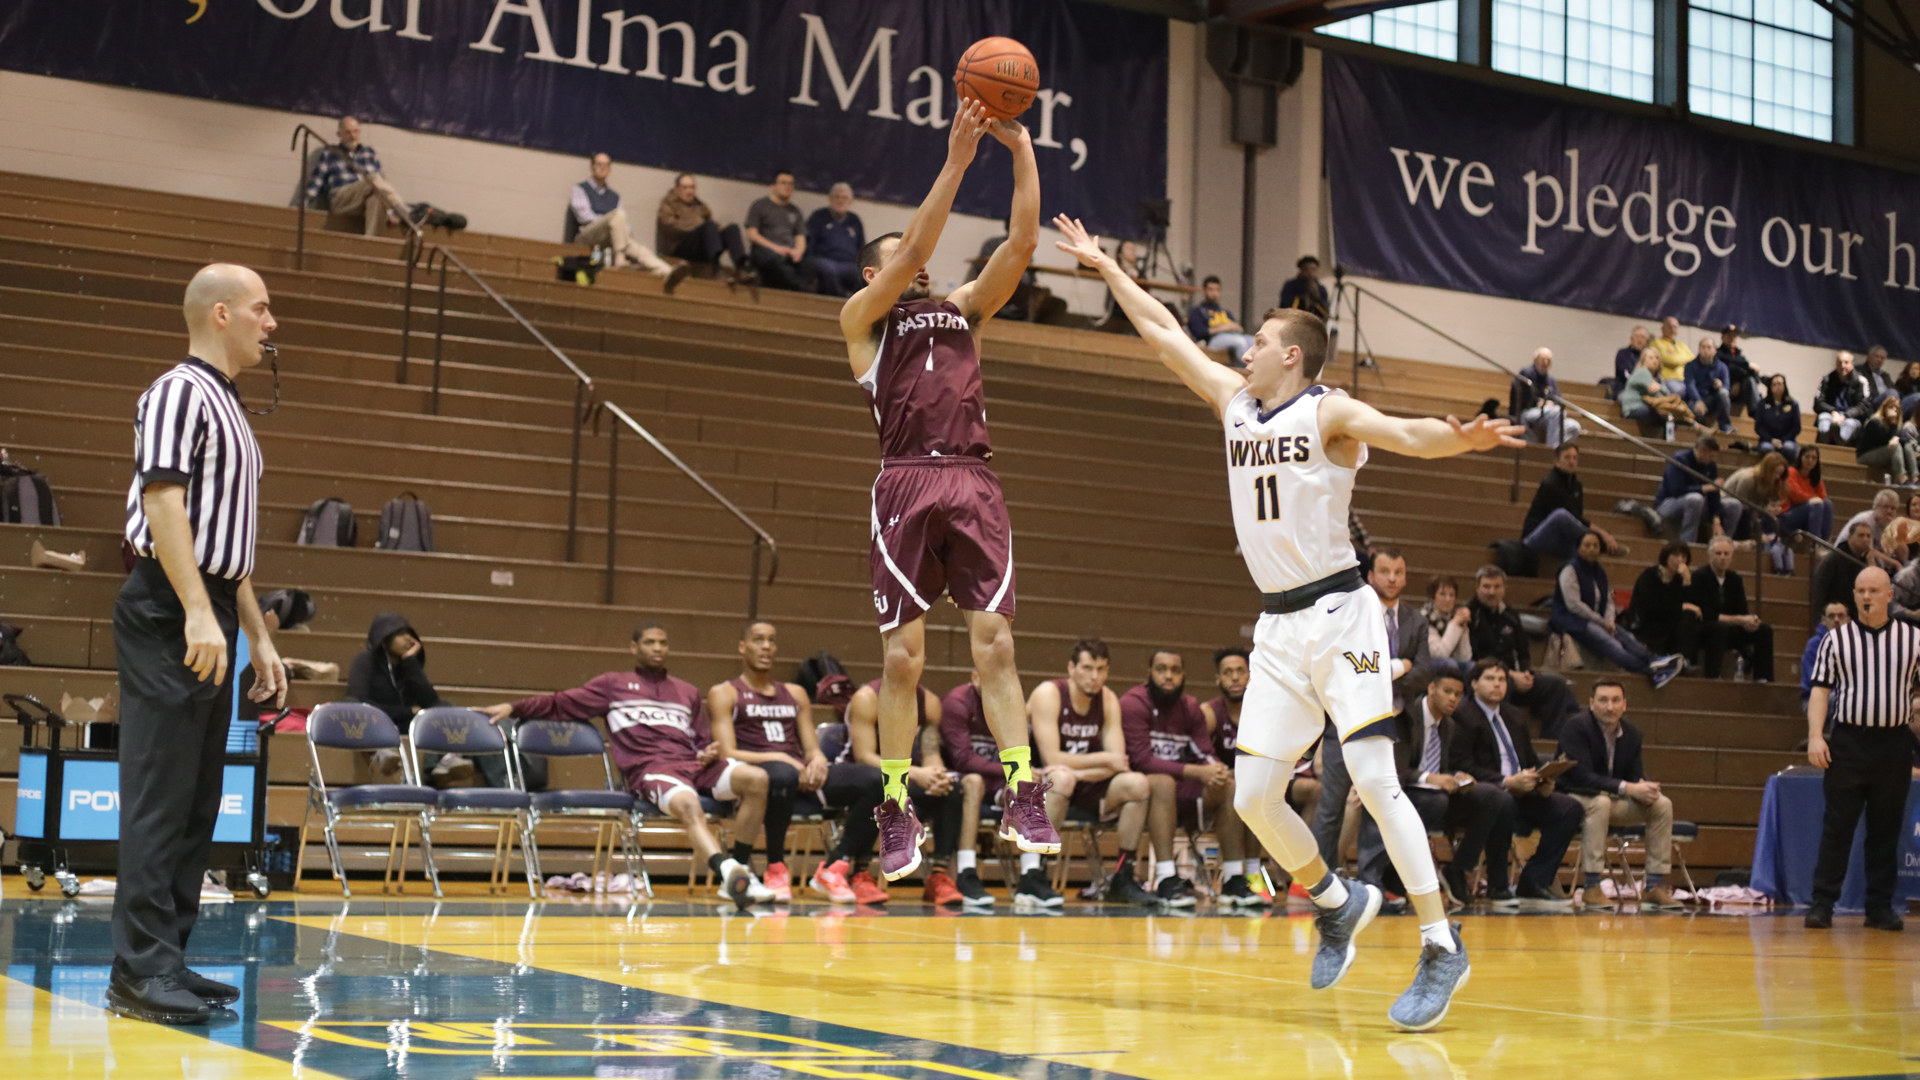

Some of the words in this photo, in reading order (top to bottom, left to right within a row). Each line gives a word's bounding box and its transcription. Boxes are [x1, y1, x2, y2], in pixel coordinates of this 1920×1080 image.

[469, 0, 755, 95] Alma
[789, 12, 1087, 171] Mar,
[994, 60, 1020, 78] THE
[1389, 147, 1495, 217] we
[1520, 148, 1737, 277] pledge
[1761, 216, 1864, 281] our
[1883, 211, 1920, 291] h
[925, 337, 934, 372] 1
[1229, 435, 1310, 468] WILKES
[1254, 473, 1281, 523] 11
[746, 704, 797, 718] EASTERN
[762, 721, 786, 743] 10
